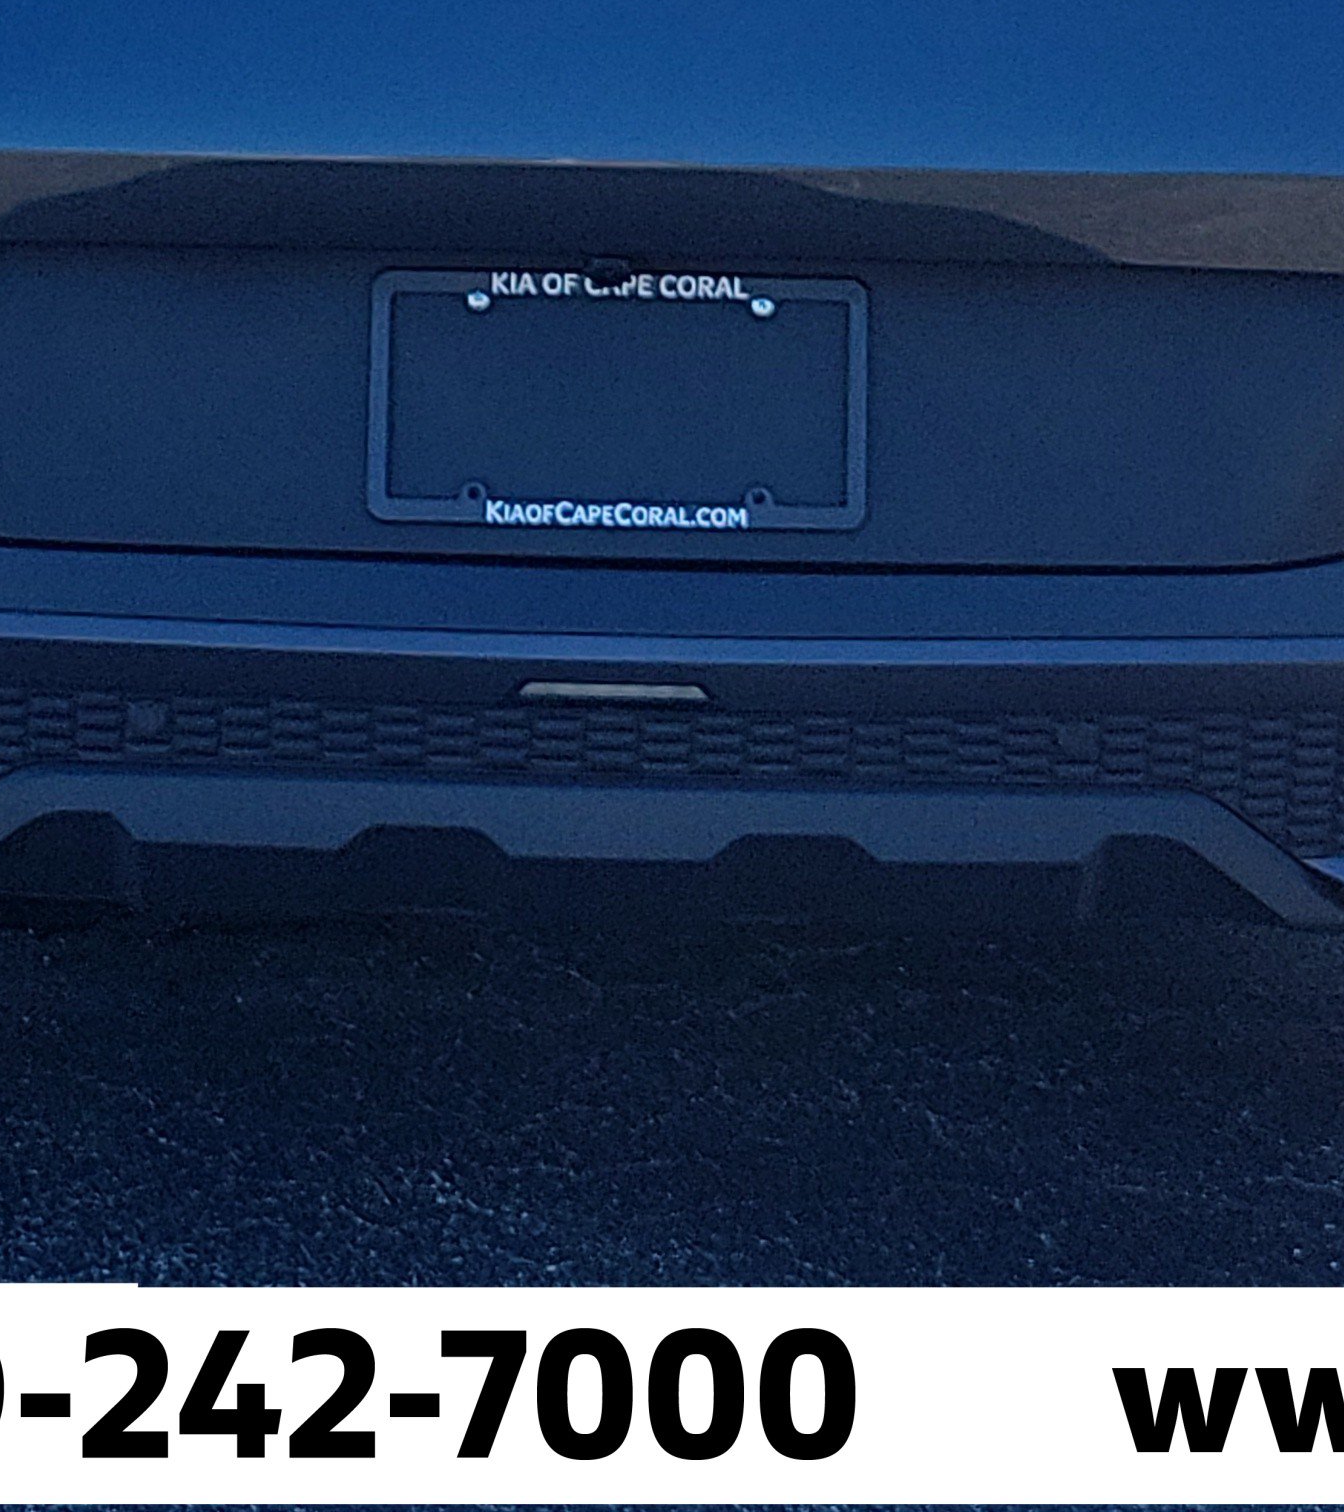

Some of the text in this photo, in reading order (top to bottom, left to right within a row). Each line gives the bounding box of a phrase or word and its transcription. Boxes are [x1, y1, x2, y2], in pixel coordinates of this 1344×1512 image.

[491, 271, 538, 296] KIA
[542, 272, 579, 297] OF
[659, 274, 751, 301] CORAL
